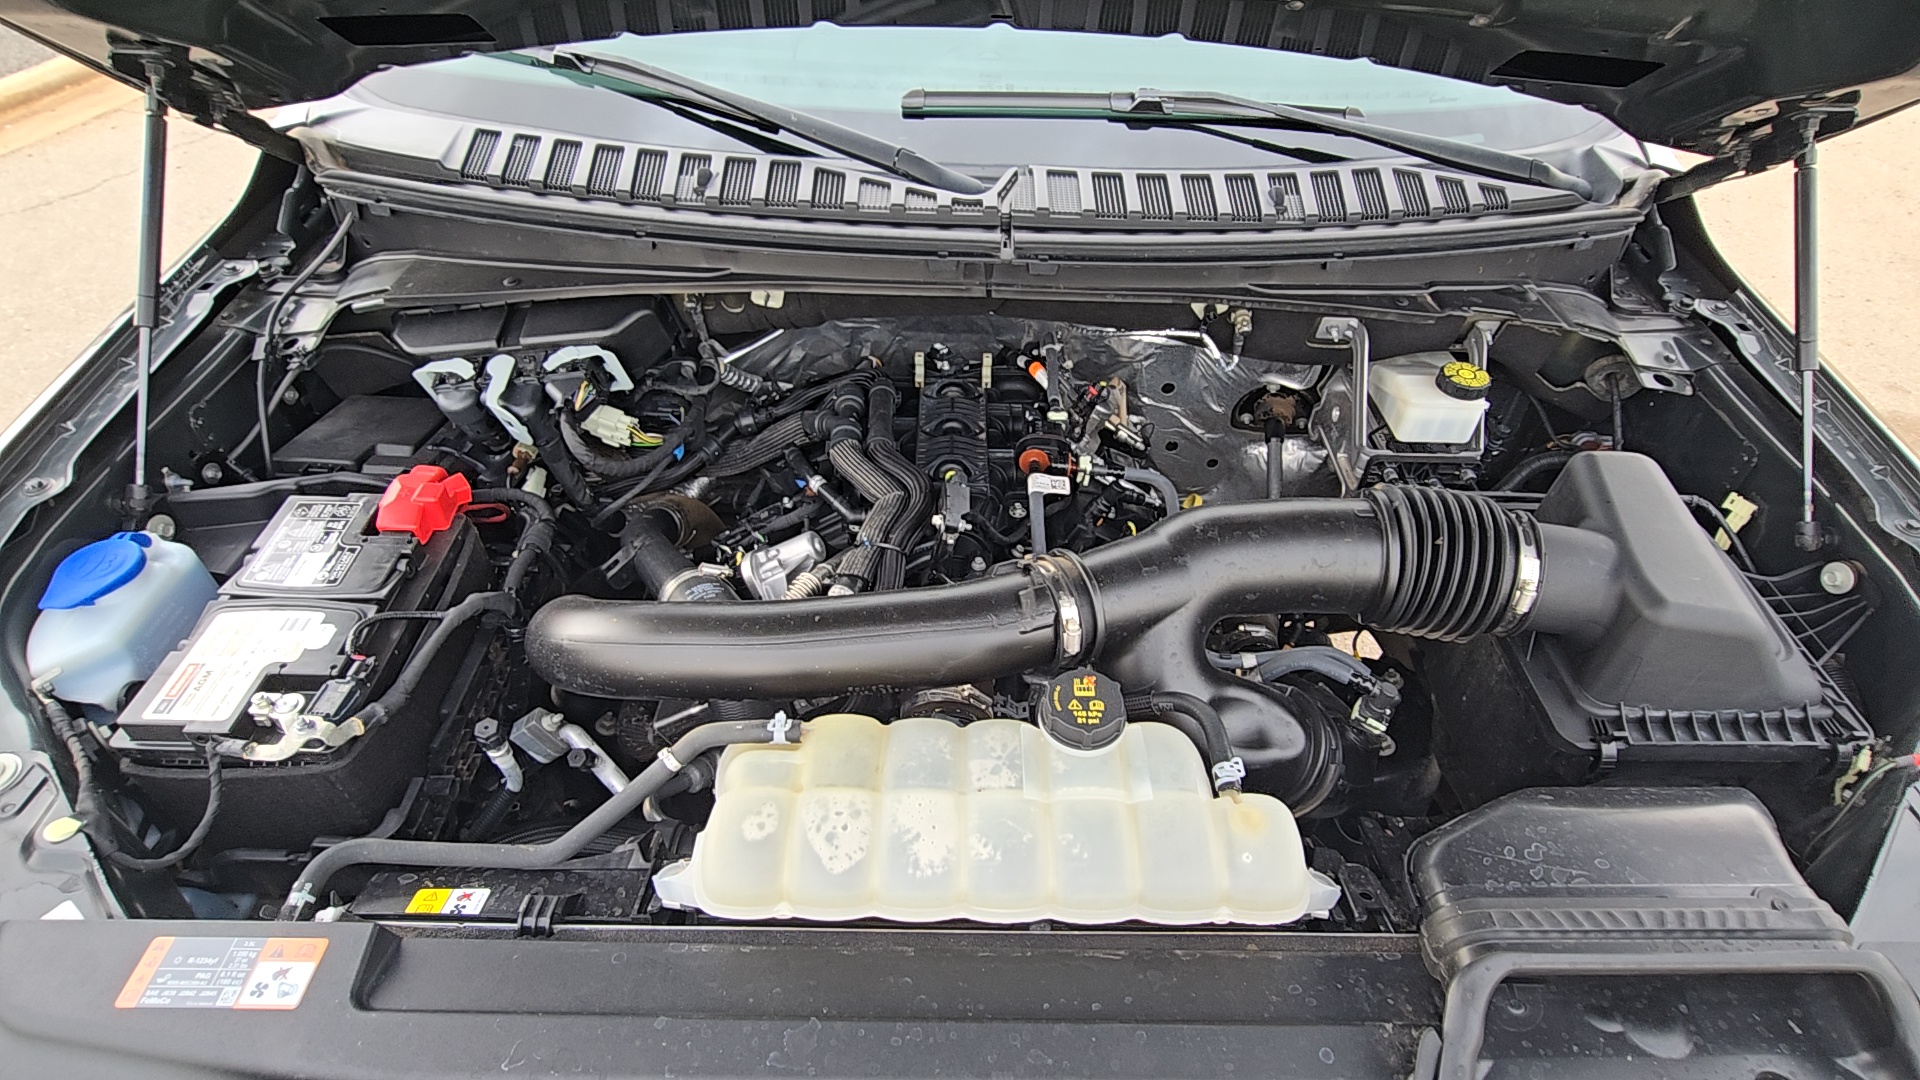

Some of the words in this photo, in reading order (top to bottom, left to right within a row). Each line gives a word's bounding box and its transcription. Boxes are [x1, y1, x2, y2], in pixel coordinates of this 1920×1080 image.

[193, 670, 214, 691] AGM
[187, 957, 219, 966] R-1234yf
[139, 996, 171, 1004] FoMoCo
